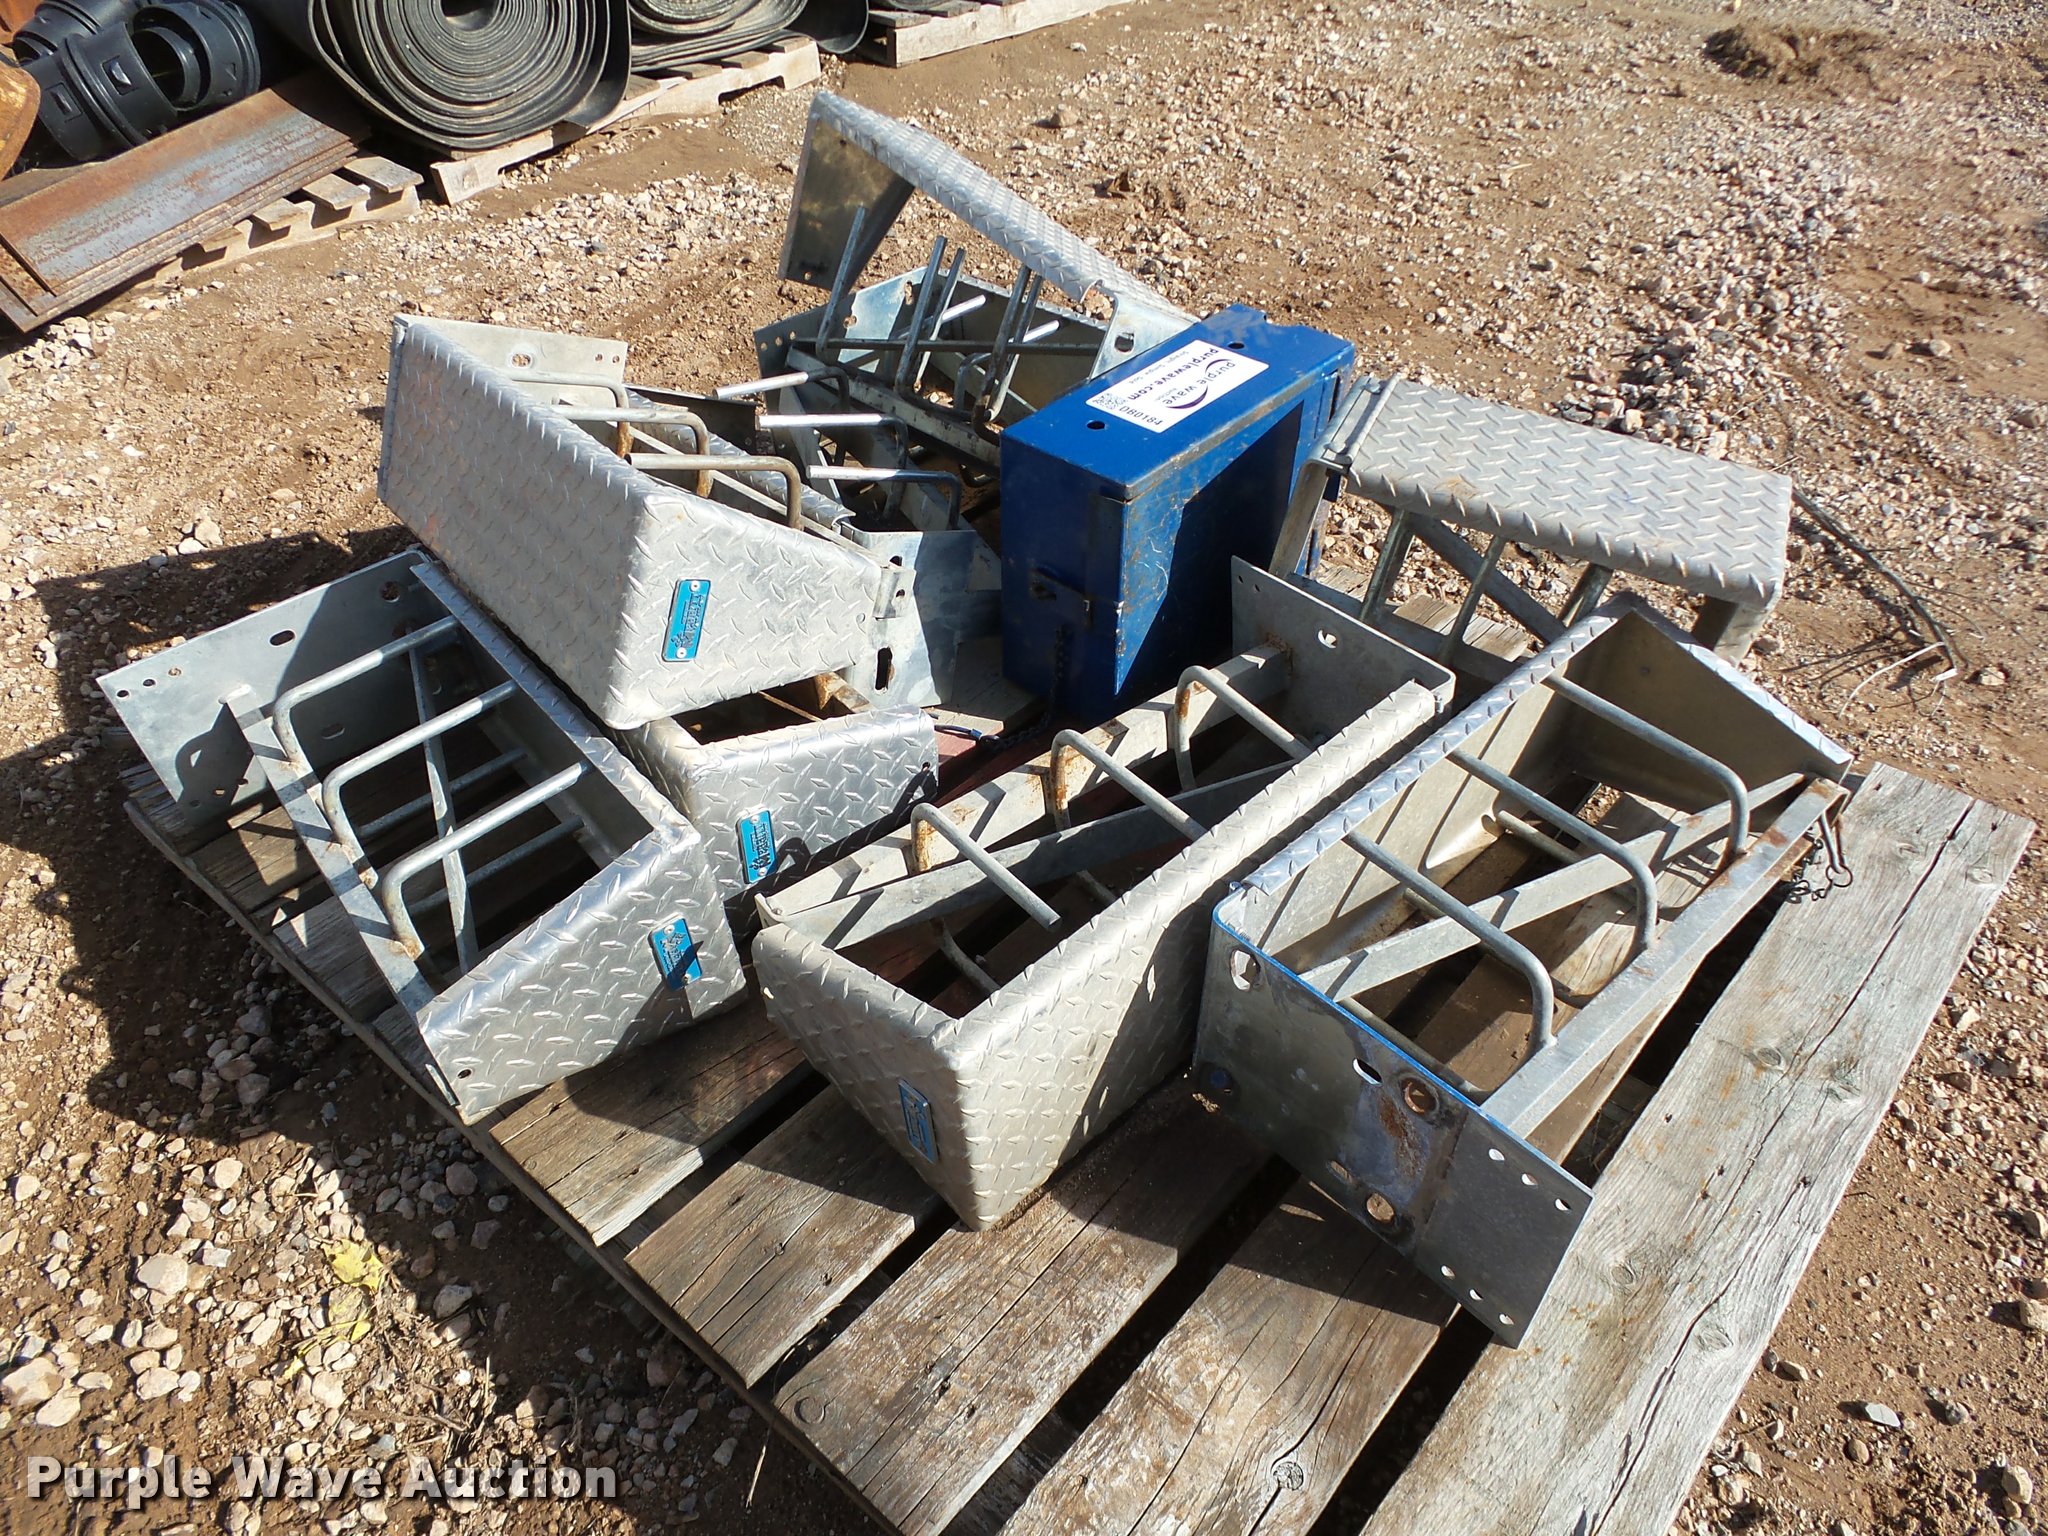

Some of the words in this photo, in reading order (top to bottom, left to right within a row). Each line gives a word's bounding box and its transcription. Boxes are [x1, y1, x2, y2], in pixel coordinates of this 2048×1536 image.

[1128, 347, 1220, 401] purplewave.com
[1196, 361, 1236, 385] purple
[1162, 385, 1198, 405] wave
